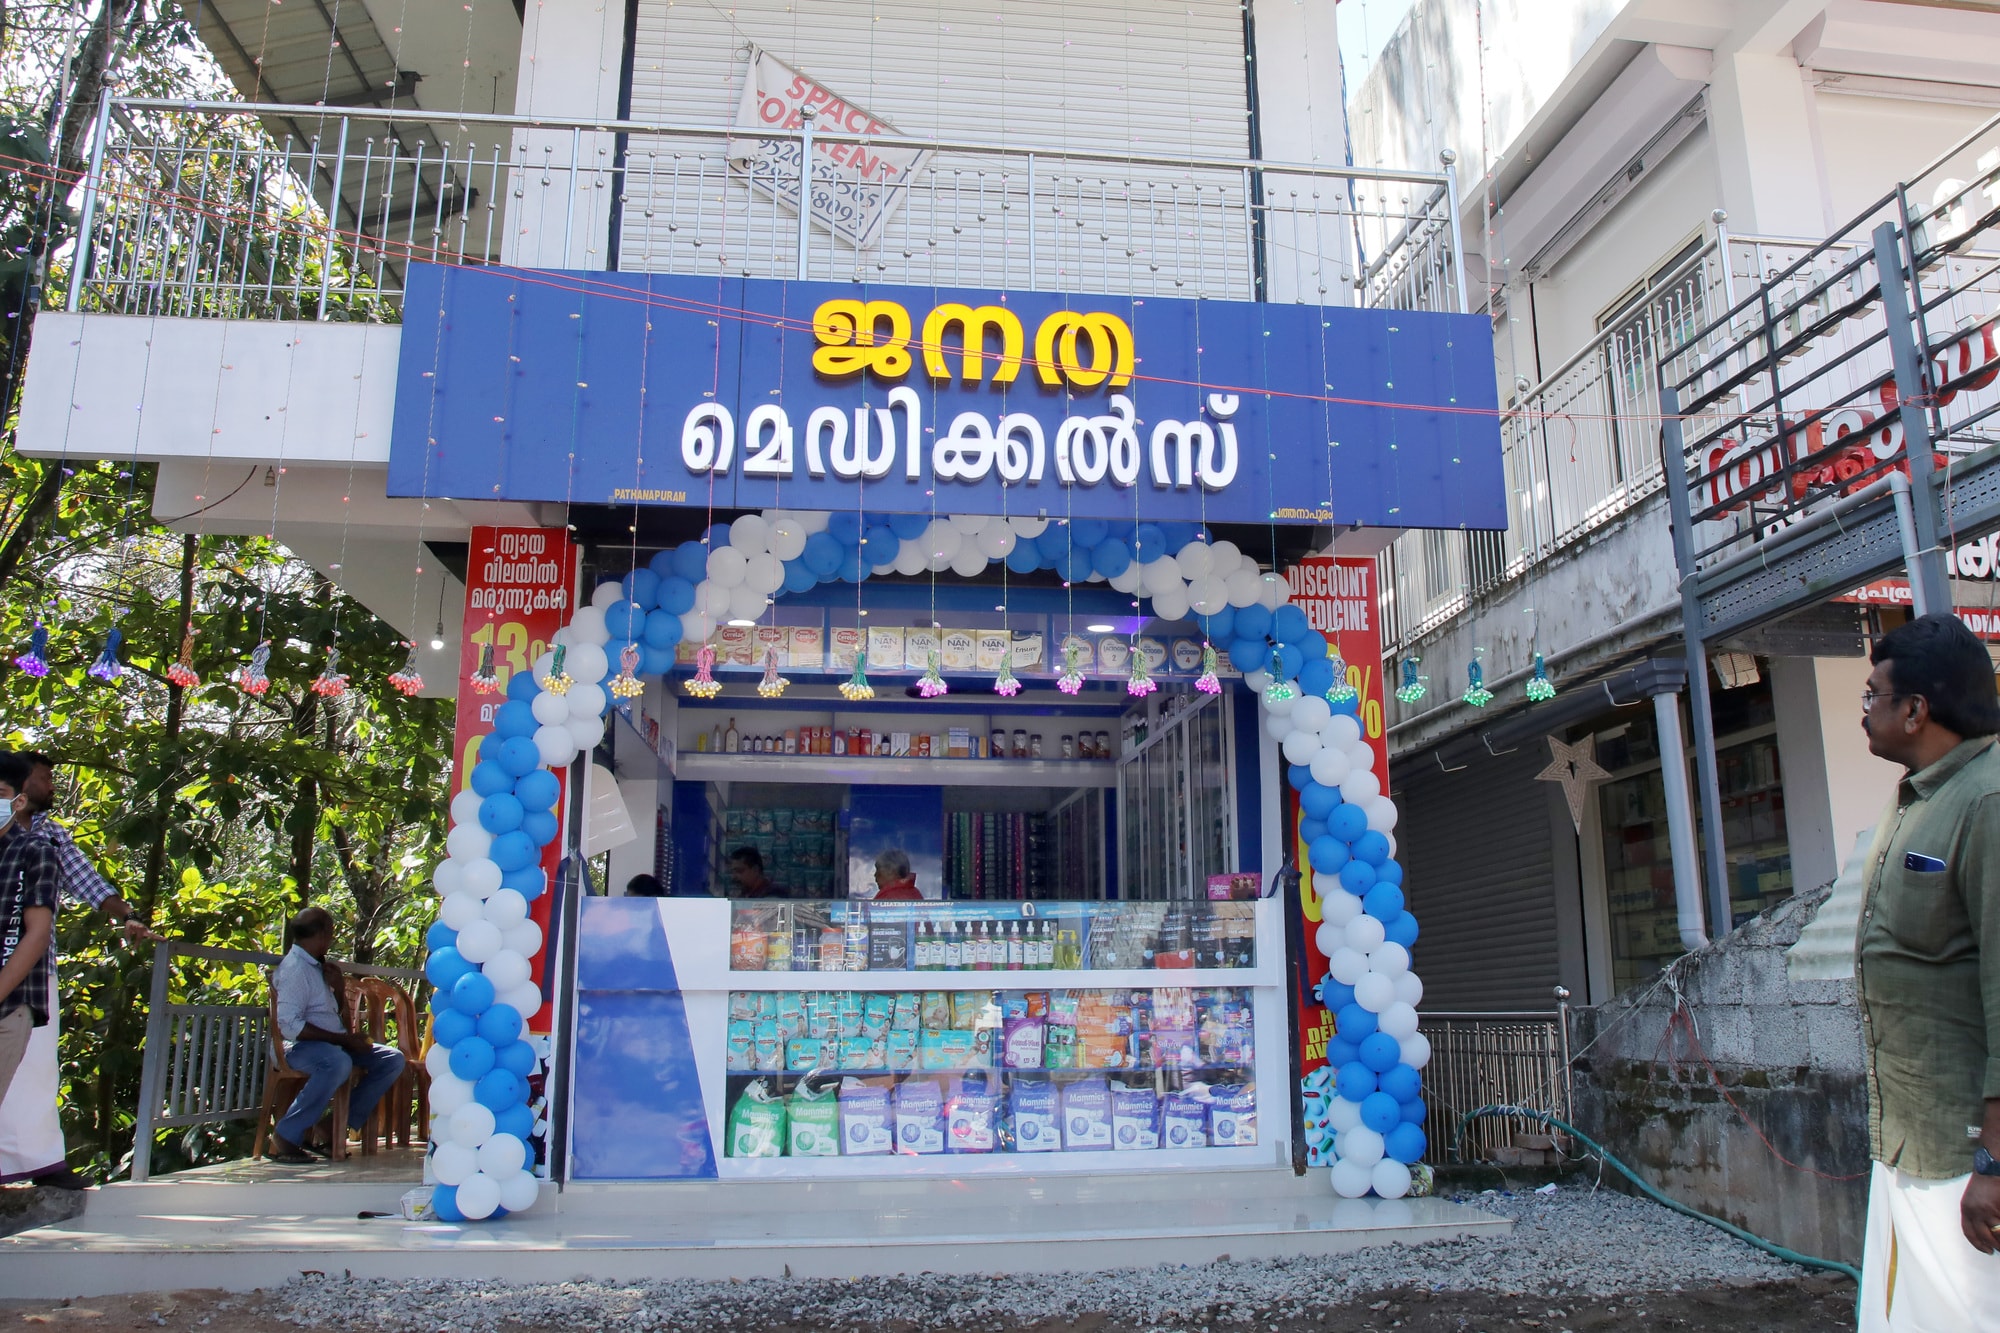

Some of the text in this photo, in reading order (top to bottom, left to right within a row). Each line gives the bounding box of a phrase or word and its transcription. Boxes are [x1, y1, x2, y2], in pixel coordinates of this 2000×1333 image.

[785, 75, 888, 136] SPACE
[812, 298, 1135, 391] ജനത
[681, 386, 1240, 491] മെഡിക്കൽസ്
[614, 488, 687, 503] PATHANAPURAM
[500, 533, 546, 560] ന്യായ
[484, 556, 558, 585] വിലയിൽ
[1288, 565, 1369, 598] DISCOUNT
[471, 587, 568, 615] മരുന്നുകൾ
[911, 638, 933, 646] NAN
[947, 639, 970, 647] NAN
[982, 640, 1005, 648] NAN
